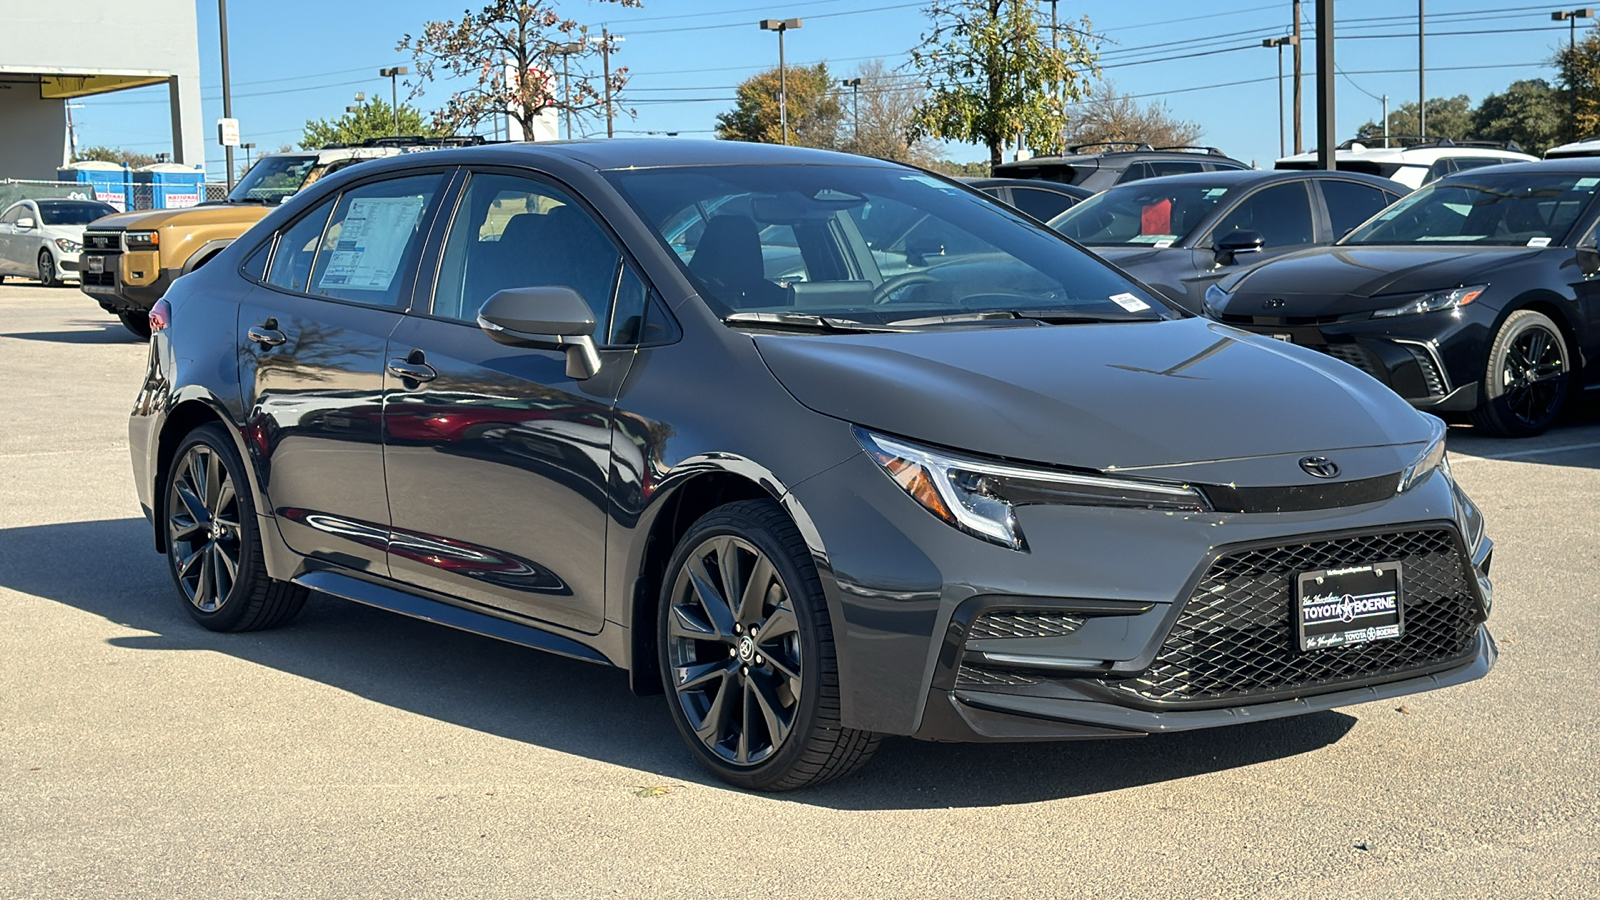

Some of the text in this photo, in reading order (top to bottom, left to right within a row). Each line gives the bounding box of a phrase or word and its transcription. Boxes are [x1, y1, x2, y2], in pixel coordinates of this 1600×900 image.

[1303, 596, 1396, 619] TOYOTA BOERNE
[1345, 632, 1367, 640] TOYOTA
